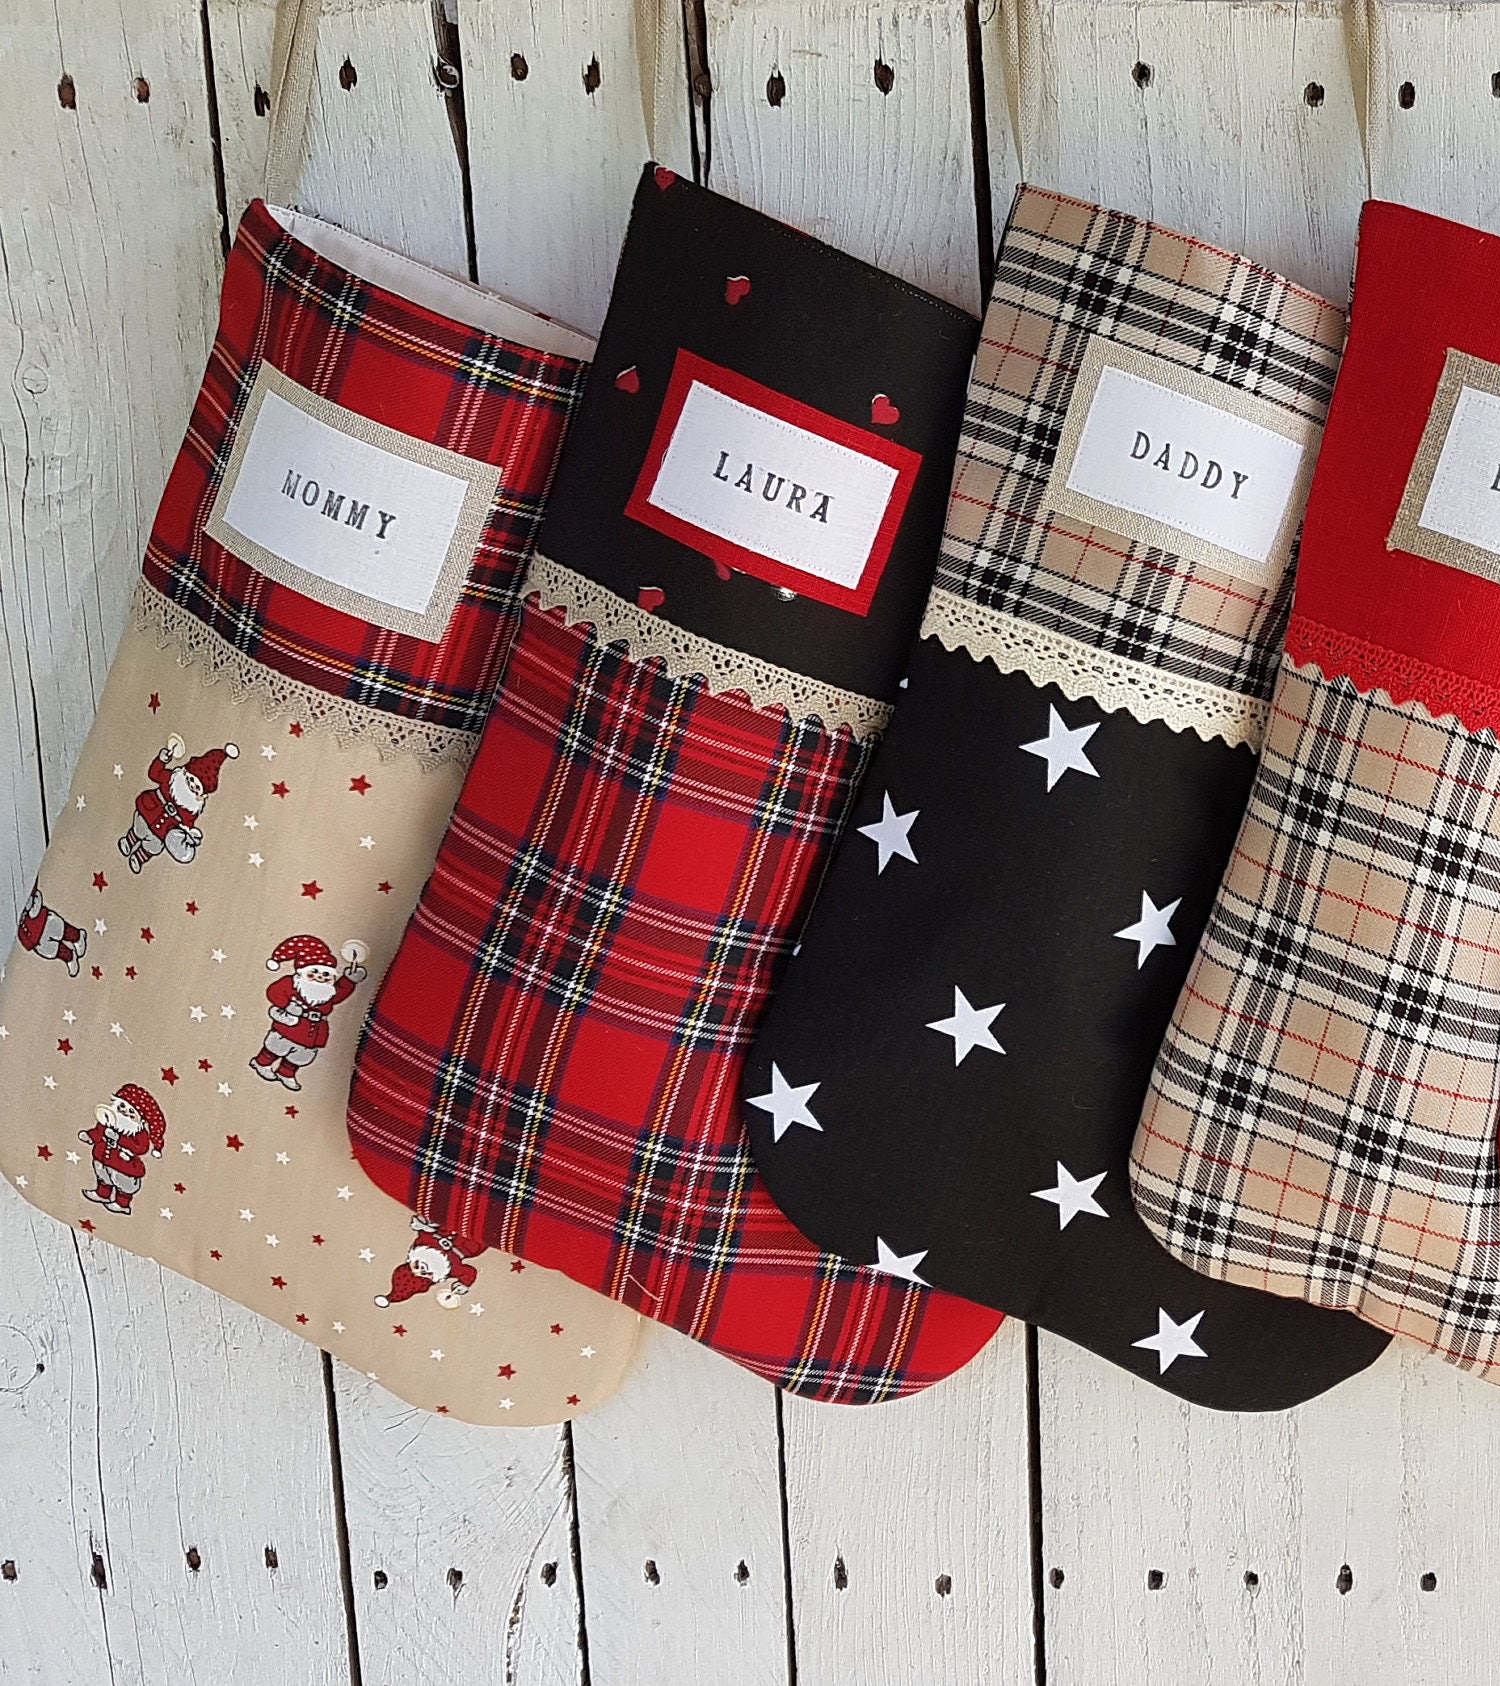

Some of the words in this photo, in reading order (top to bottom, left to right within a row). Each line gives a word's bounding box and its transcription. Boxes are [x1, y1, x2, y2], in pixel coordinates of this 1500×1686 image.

[713, 451, 829, 523] LAURA
[1130, 431, 1248, 499] DADDY
[281, 469, 396, 539] MOMMY
